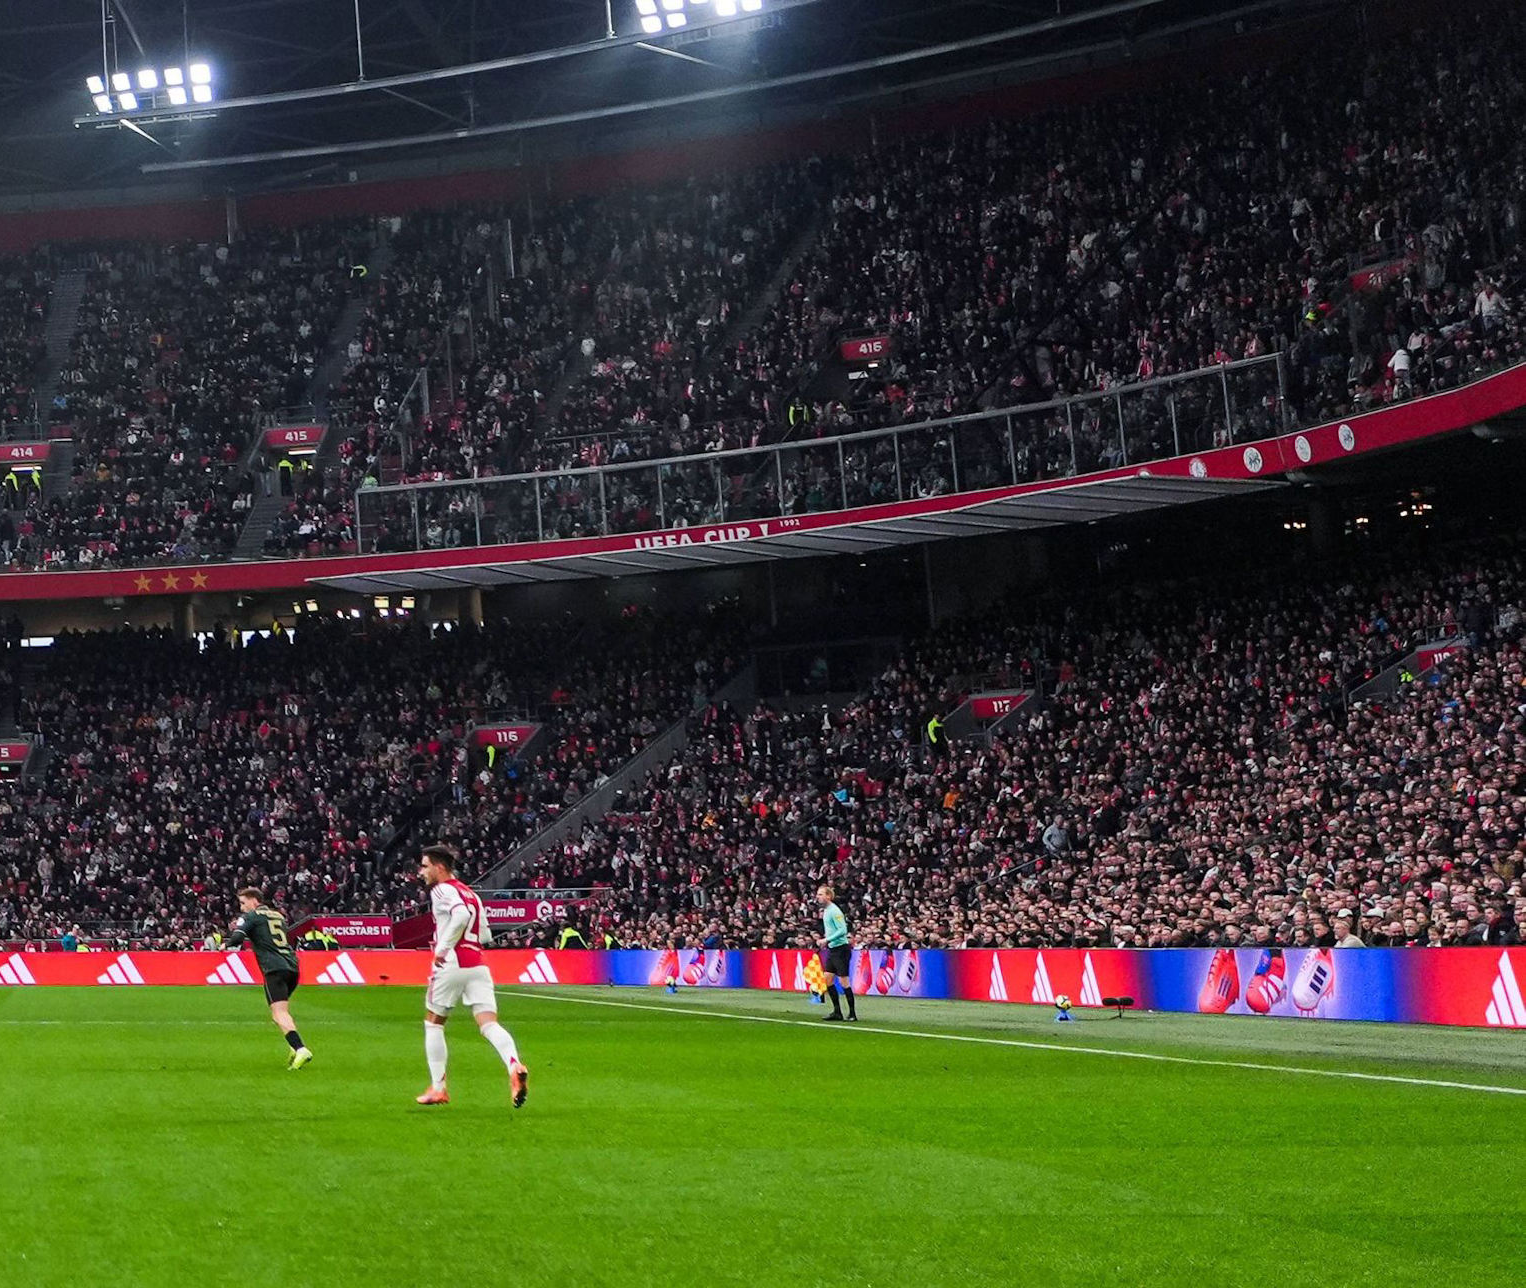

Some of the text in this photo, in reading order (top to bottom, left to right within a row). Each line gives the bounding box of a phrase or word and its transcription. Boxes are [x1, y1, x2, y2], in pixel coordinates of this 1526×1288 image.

[285, 431, 308, 441] 415
[11, 447, 33, 457] 414
[634, 527, 750, 550] UEFA CUP
[485, 906, 525, 918] ComAve
[267, 919, 289, 947] 5
[381, 926, 391, 935] IT
